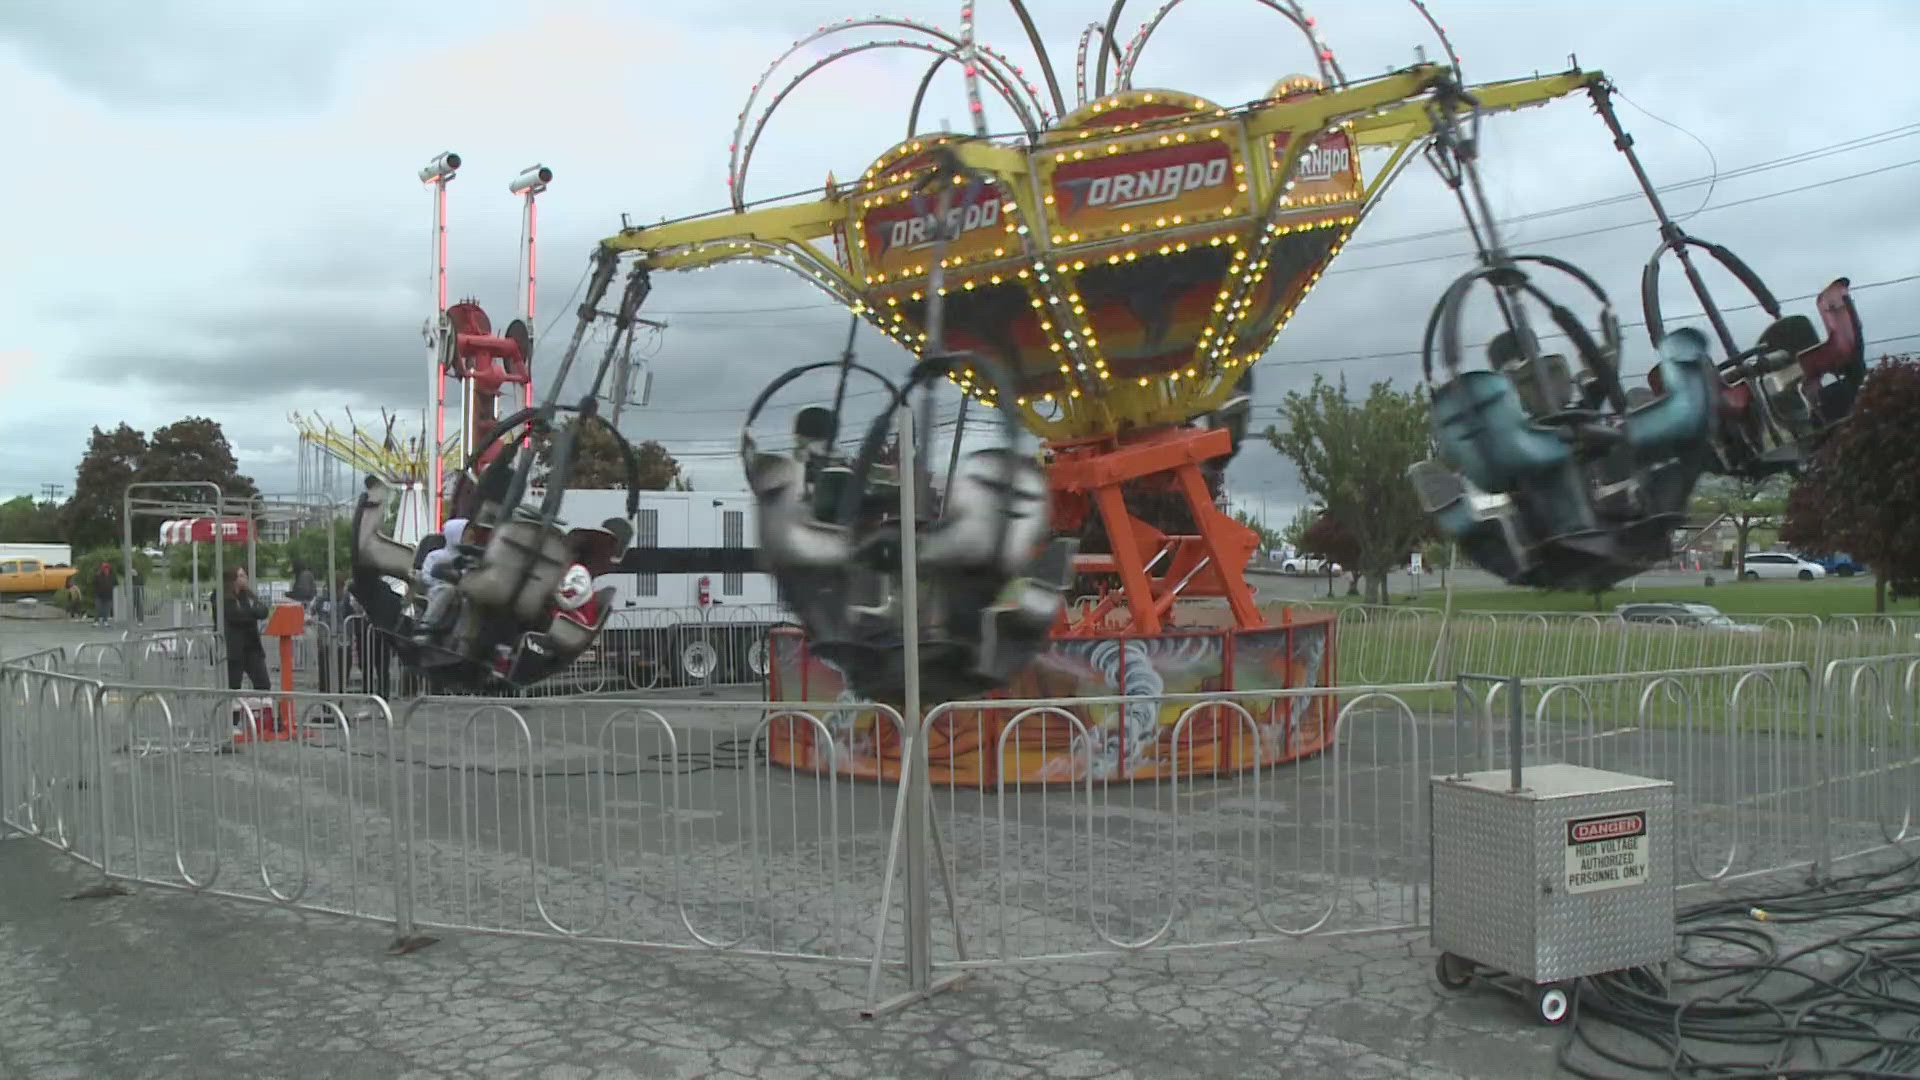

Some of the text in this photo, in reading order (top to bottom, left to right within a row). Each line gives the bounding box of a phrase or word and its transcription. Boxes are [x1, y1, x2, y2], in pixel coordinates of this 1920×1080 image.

[1276, 147, 1349, 181] RNADO
[210, 522, 239, 535] ETER
[1579, 820, 1636, 837] DANGER
[1576, 837, 1638, 857] HIGH VOLTAGE
[1581, 853, 1634, 870] AUTHORIZED
[1569, 864, 1645, 886] PERSONNEL ONLY
